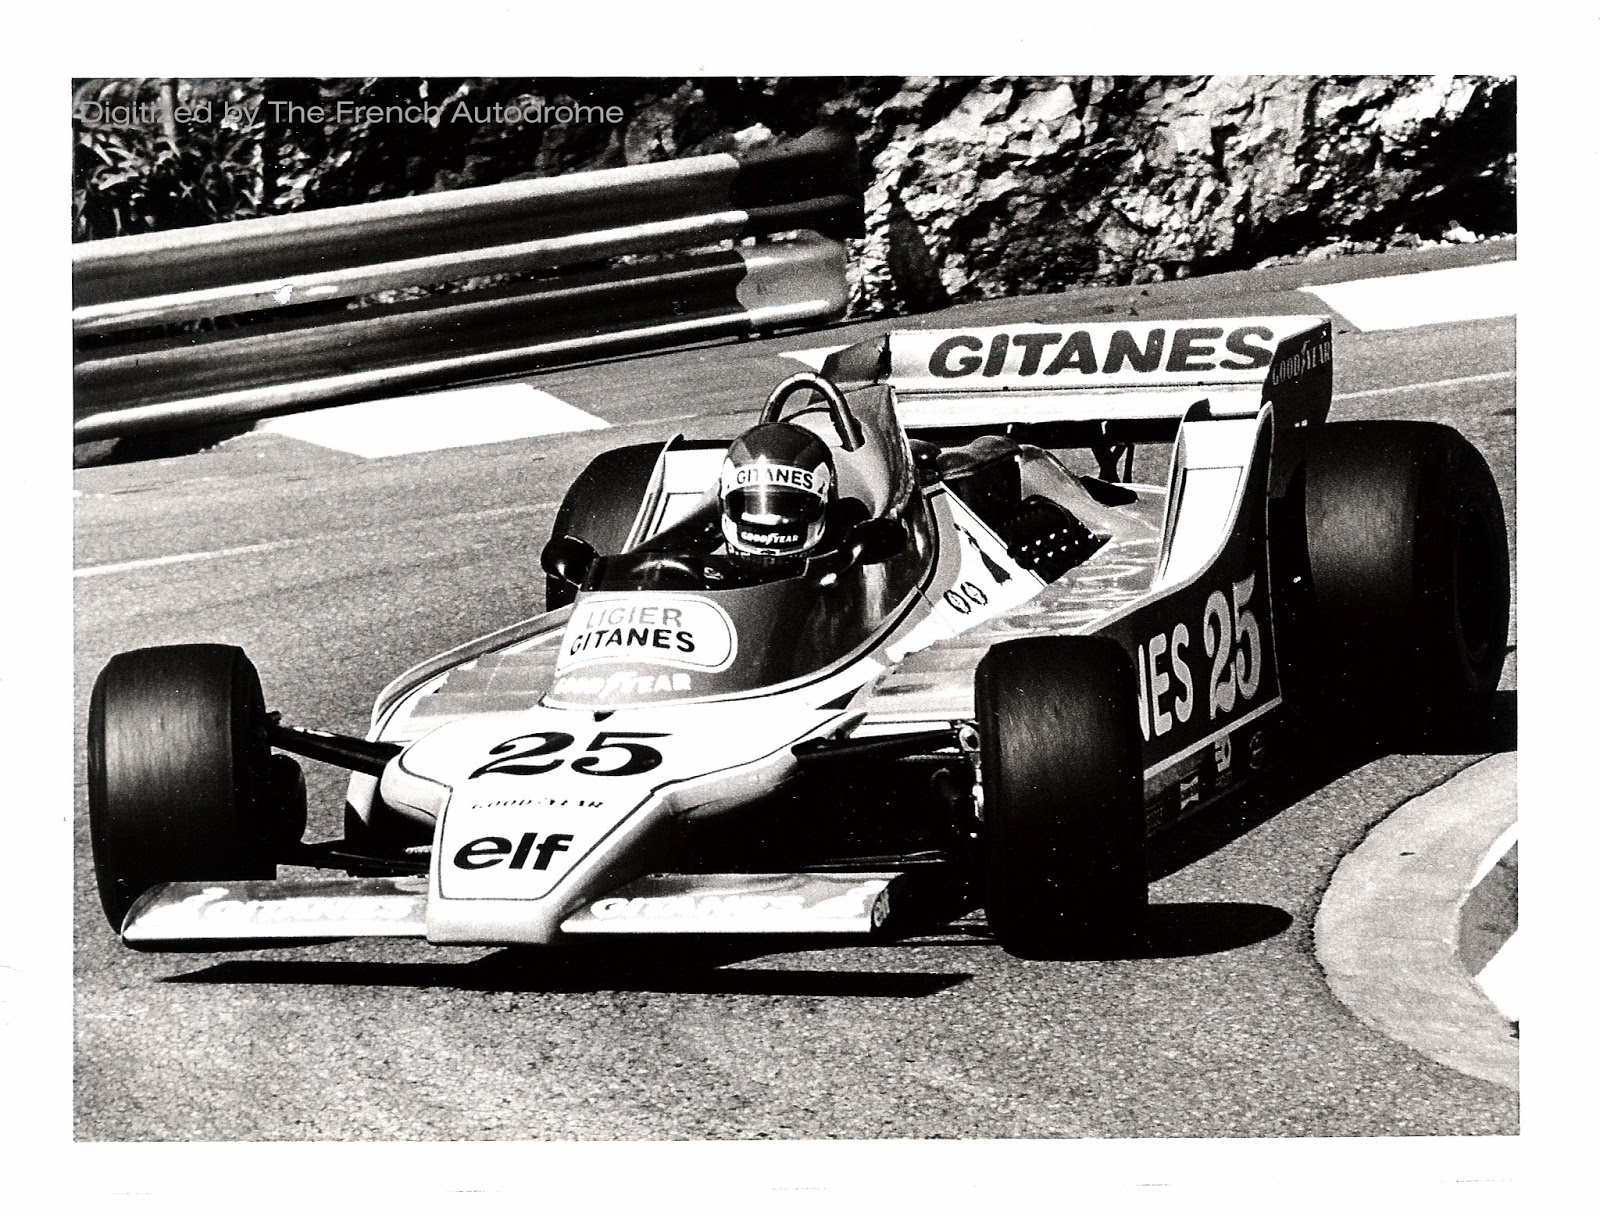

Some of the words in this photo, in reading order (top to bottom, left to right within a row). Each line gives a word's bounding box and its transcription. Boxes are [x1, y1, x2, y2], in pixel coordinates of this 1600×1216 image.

[928, 326, 1274, 378] GITANES
[586, 606, 684, 630] LIGIER
[569, 627, 696, 656] GITANES
[1203, 571, 1262, 720] 25
[468, 731, 674, 780] 25
[453, 832, 575, 871] elf
